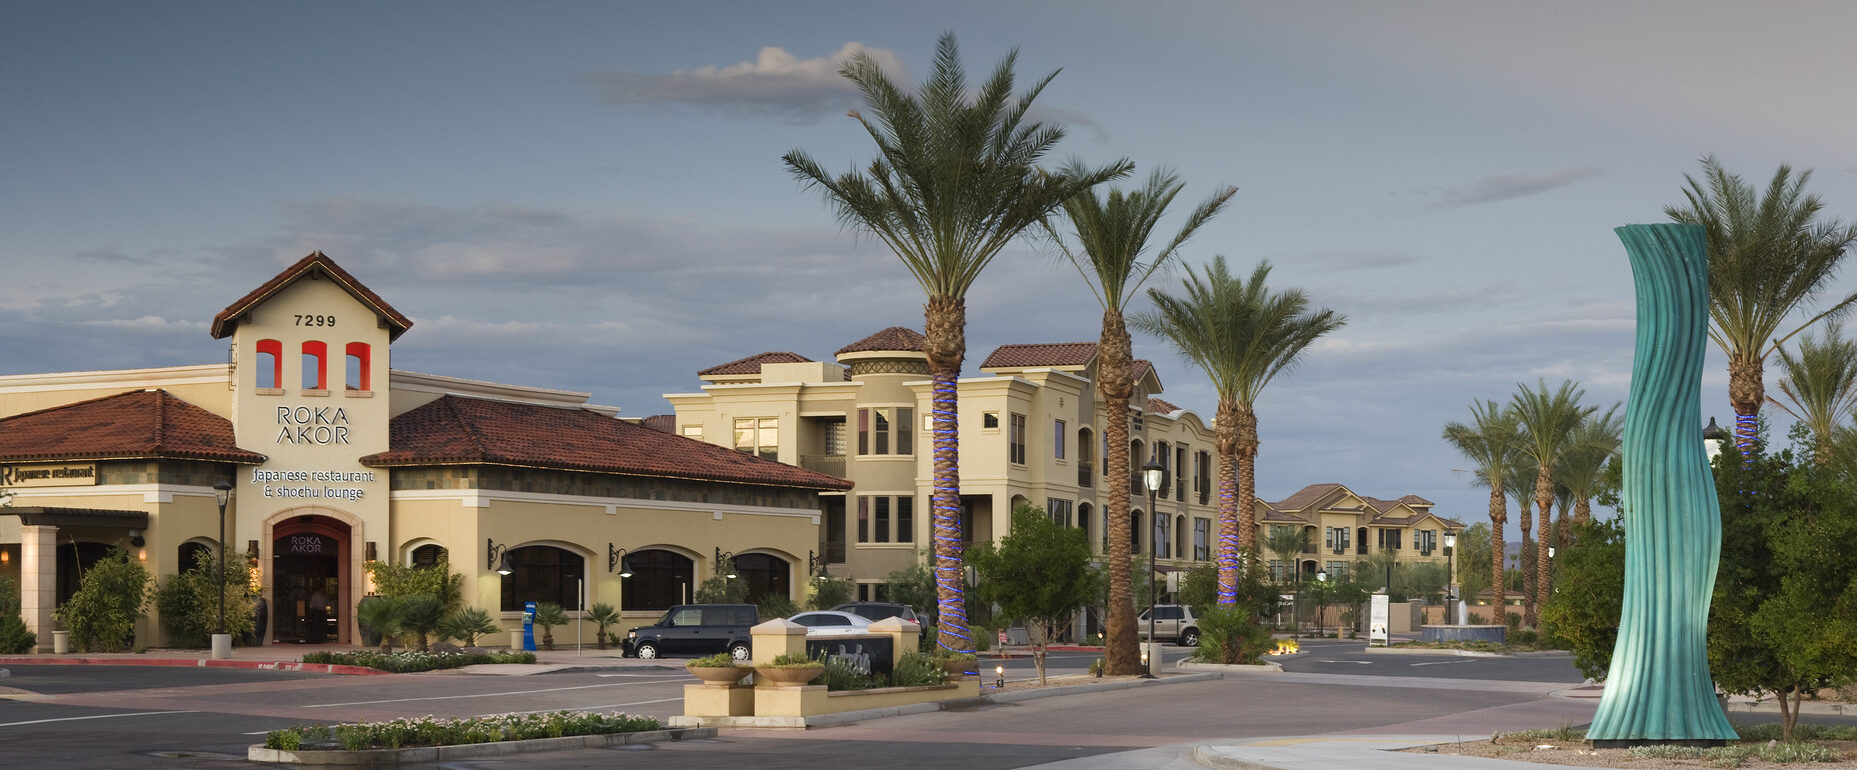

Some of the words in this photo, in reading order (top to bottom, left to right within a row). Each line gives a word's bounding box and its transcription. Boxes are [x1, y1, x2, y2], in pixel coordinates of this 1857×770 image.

[294, 314, 336, 327] 7299
[276, 406, 350, 425] ROKA
[276, 426, 350, 445] AKOR
[52, 465, 94, 479] restaurant
[252, 468, 308, 484] japanese
[311, 470, 374, 482] restaurant
[264, 485, 273, 497] &
[277, 485, 319, 498] shochu
[324, 485, 364, 500] lounge
[291, 536, 321, 545] ROKA
[291, 544, 321, 552] AKOR
